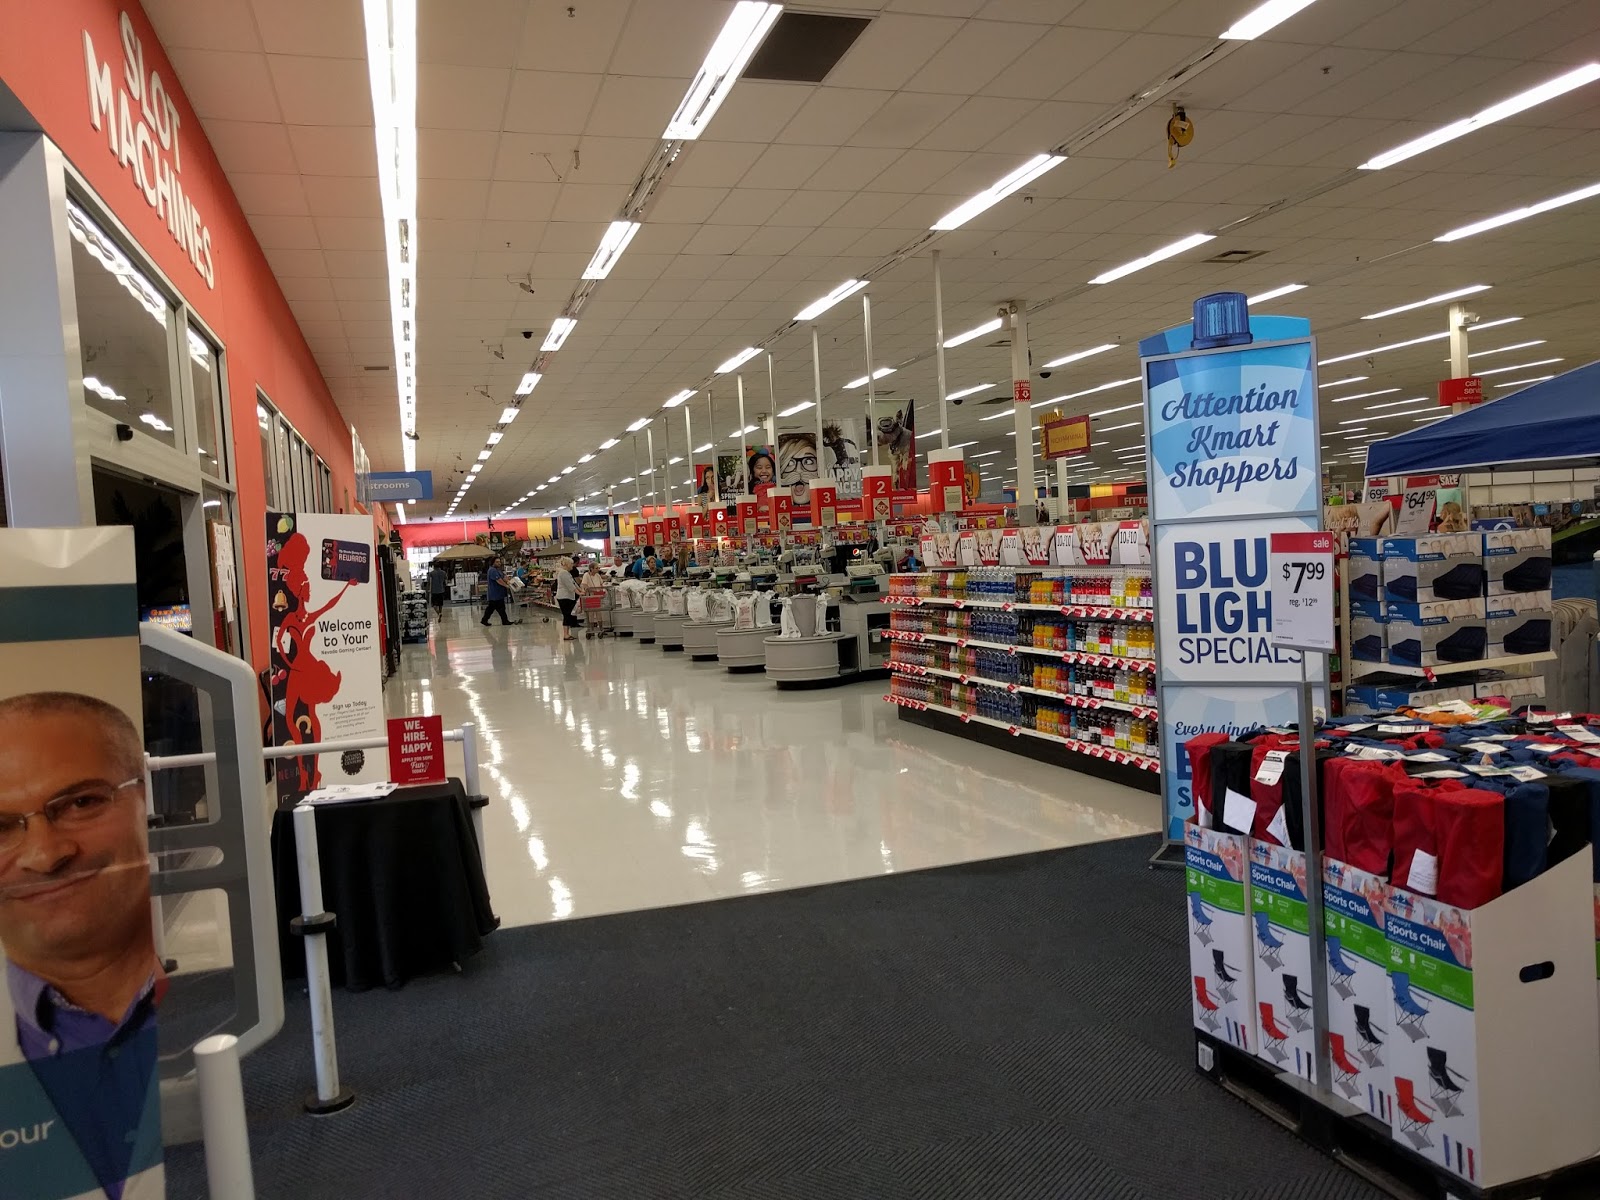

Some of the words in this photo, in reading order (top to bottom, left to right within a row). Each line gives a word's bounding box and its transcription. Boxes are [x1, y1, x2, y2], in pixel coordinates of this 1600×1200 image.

[119, 10, 182, 174] SLOT
[82, 29, 215, 290] MACHINES
[1161, 382, 1299, 421] Attention
[1186, 420, 1281, 459] Kmart
[948, 466, 957, 481] 1
[1170, 456, 1298, 493] Shoppers
[835, 481, 861, 493] NCE!
[876, 481, 886, 494] 2
[779, 499, 788, 509] 4
[823, 491, 831, 503] 3
[1124, 496, 1148, 505] FITTI
[716, 511, 724, 521] 6
[746, 506, 753, 515] 5
[693, 515, 699, 524] 7
[1313, 538, 1330, 548] sale
[980, 545, 998, 561] SALE
[1025, 544, 1048, 560] SALE
[1084, 542, 1109, 560] SALE
[338, 553, 367, 564] REWARDS
[1174, 537, 1268, 590] BLU
[1289, 599, 1301, 607] reg.
[1176, 591, 1272, 634] LIGH
[318, 619, 372, 632] Welcome
[324, 636, 338, 647] to
[342, 634, 368, 645] Your
[404, 720, 424, 731] WE.
[403, 731, 429, 742] HIRE.
[401, 742, 433, 754] HAPPY.
[1187, 852, 1205, 866] Sports
[1206, 859, 1222, 872] Chair
[1252, 868, 1275, 884] Sports
[1275, 878, 1296, 891] Chair
[1324, 890, 1347, 908] Sports
[1348, 900, 1369, 916] Chair
[1387, 921, 1418, 941] Sports
[1419, 933, 1446, 951] Chair
[0, 1119, 56, 1148] our
